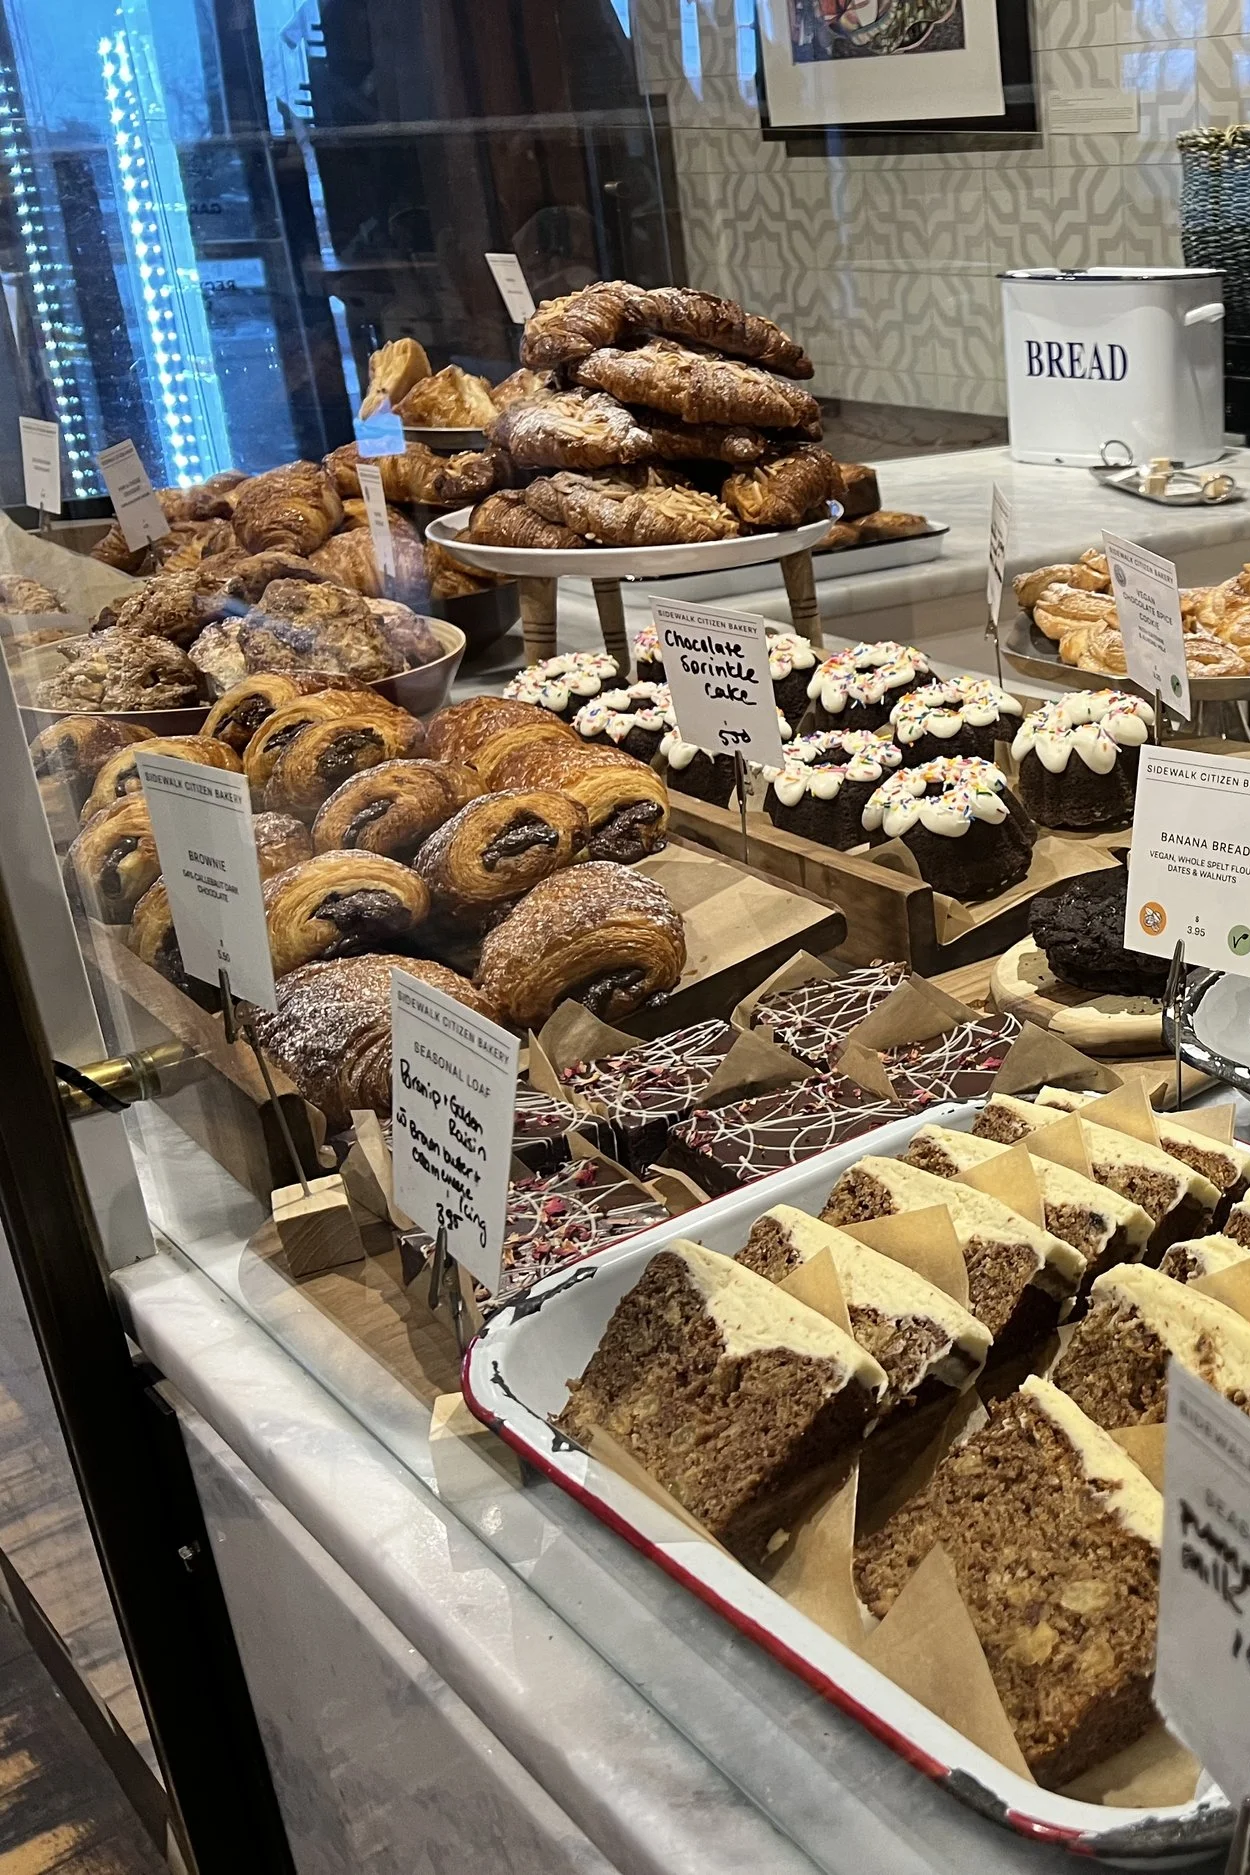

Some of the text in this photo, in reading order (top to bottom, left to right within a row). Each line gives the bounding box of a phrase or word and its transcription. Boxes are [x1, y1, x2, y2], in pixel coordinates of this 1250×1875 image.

[1024, 340, 1129, 381] BREAD
[1122, 591, 1173, 626] CHOCOLATE SPICE
[1136, 589, 1156, 605] VEGAN
[658, 609, 758, 634] SIDEWALK CITIZEN BAKERY
[1139, 612, 1160, 631] COOKIE
[665, 629, 745, 659] Chocolate
[145, 771, 242, 805] SIDEWALK CITIZEN BAKERY
[1147, 764, 1197, 780] SIDEWALK
[1200, 772, 1240, 787] CITIZEN
[1160, 832, 1250, 857] BANANA BREAD
[188, 850, 227, 872] BROWNIE
[1149, 850, 1176, 863] VEGAN,
[1178, 855, 1205, 867] WHOLE
[1207, 860, 1229, 871] SPELT
[1167, 865, 1237, 884] DATES & WALNUTS
[1187, 925, 1206, 937] 3.95
[398, 990, 509, 1064] SIDEWALK CITIZEN BAKERY
[414, 1041, 491, 1098] SEASONAL LOAF
